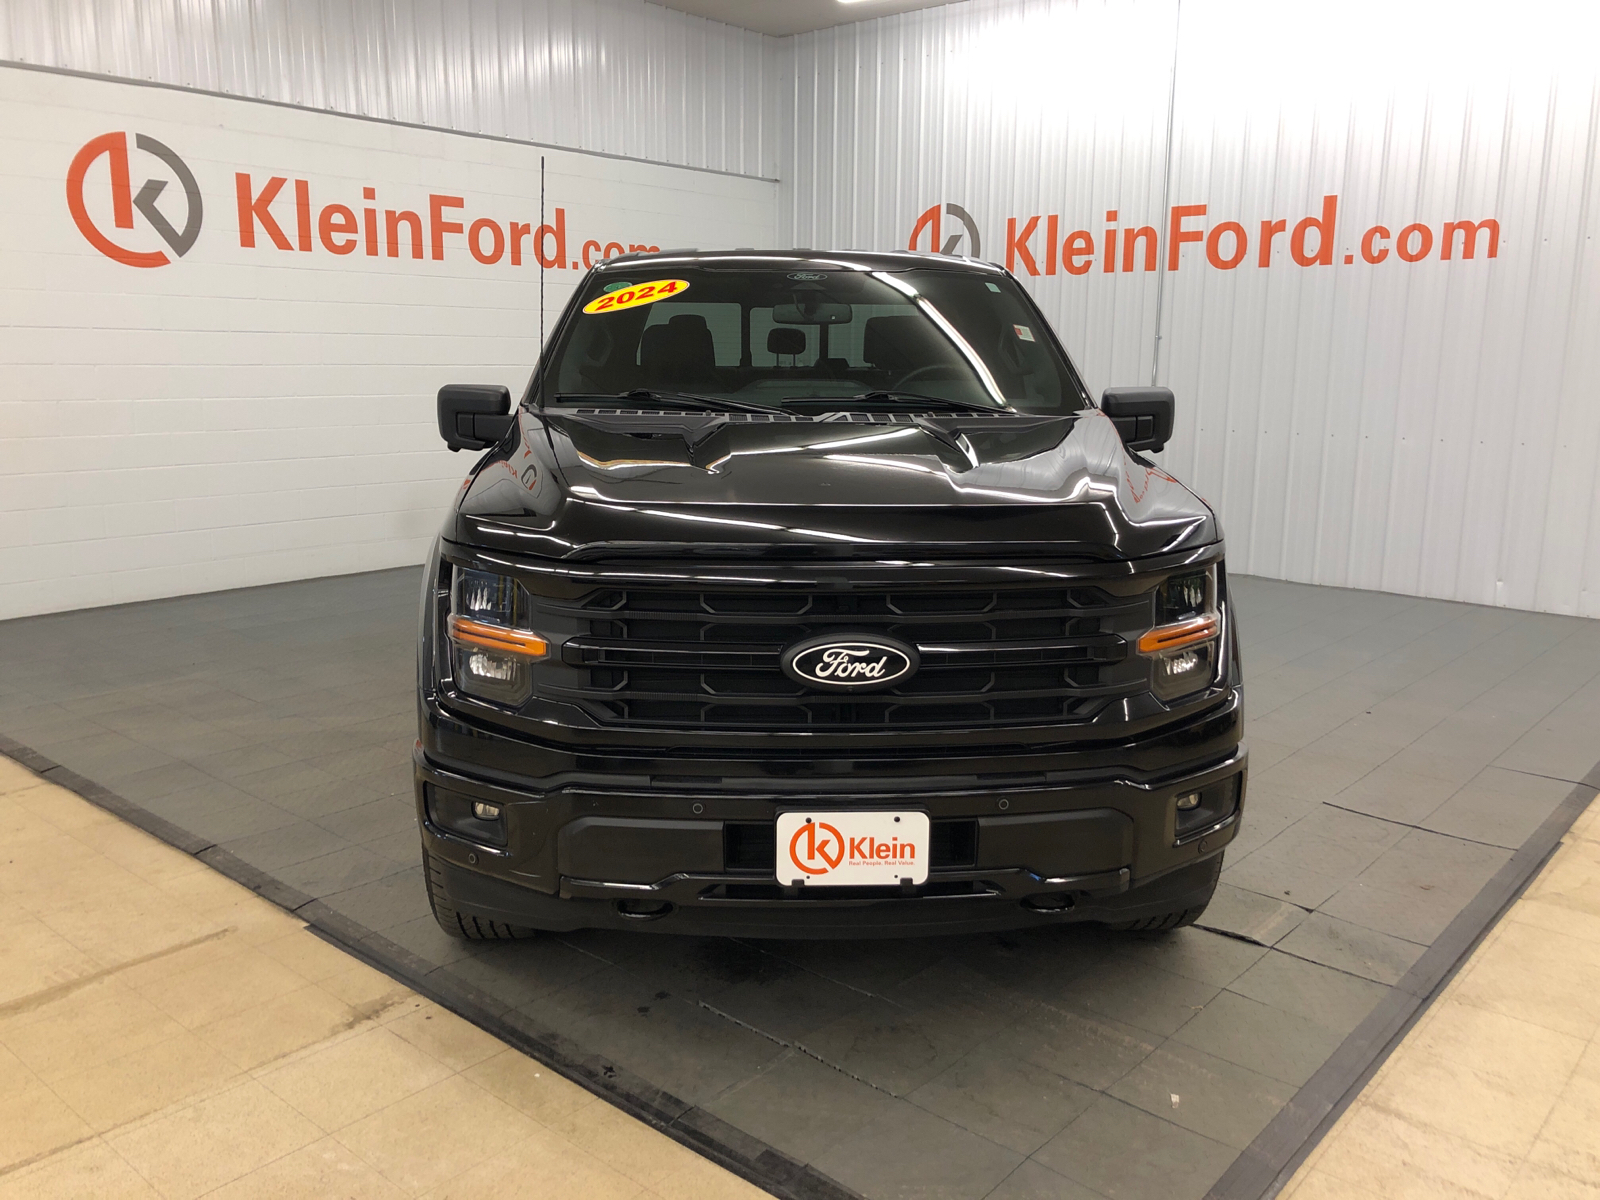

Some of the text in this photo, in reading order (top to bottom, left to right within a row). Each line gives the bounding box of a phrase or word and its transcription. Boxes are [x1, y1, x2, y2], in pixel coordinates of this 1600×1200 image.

[235, 172, 661, 271] KleinFord.c
[1005, 195, 1501, 277] KleinFord.com
[595, 281, 678, 311] 2024
[815, 648, 888, 678] Ford
[849, 837, 916, 860] Klein
